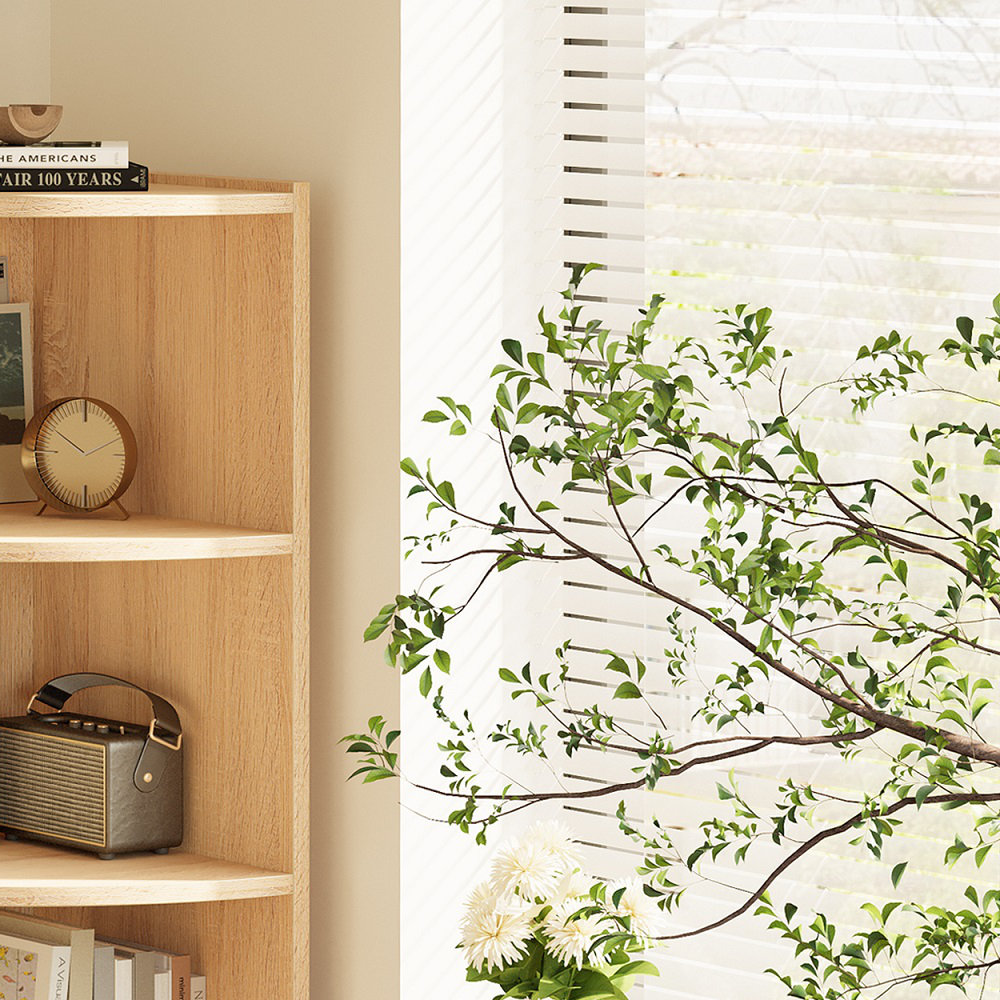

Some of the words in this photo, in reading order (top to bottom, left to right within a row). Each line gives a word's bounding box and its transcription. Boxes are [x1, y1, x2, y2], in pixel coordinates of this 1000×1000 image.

[18, 154, 96, 162] AMERICANS
[38, 172, 62, 186] 100
[66, 172, 122, 186] YEARS
[58, 956, 66, 968] A
